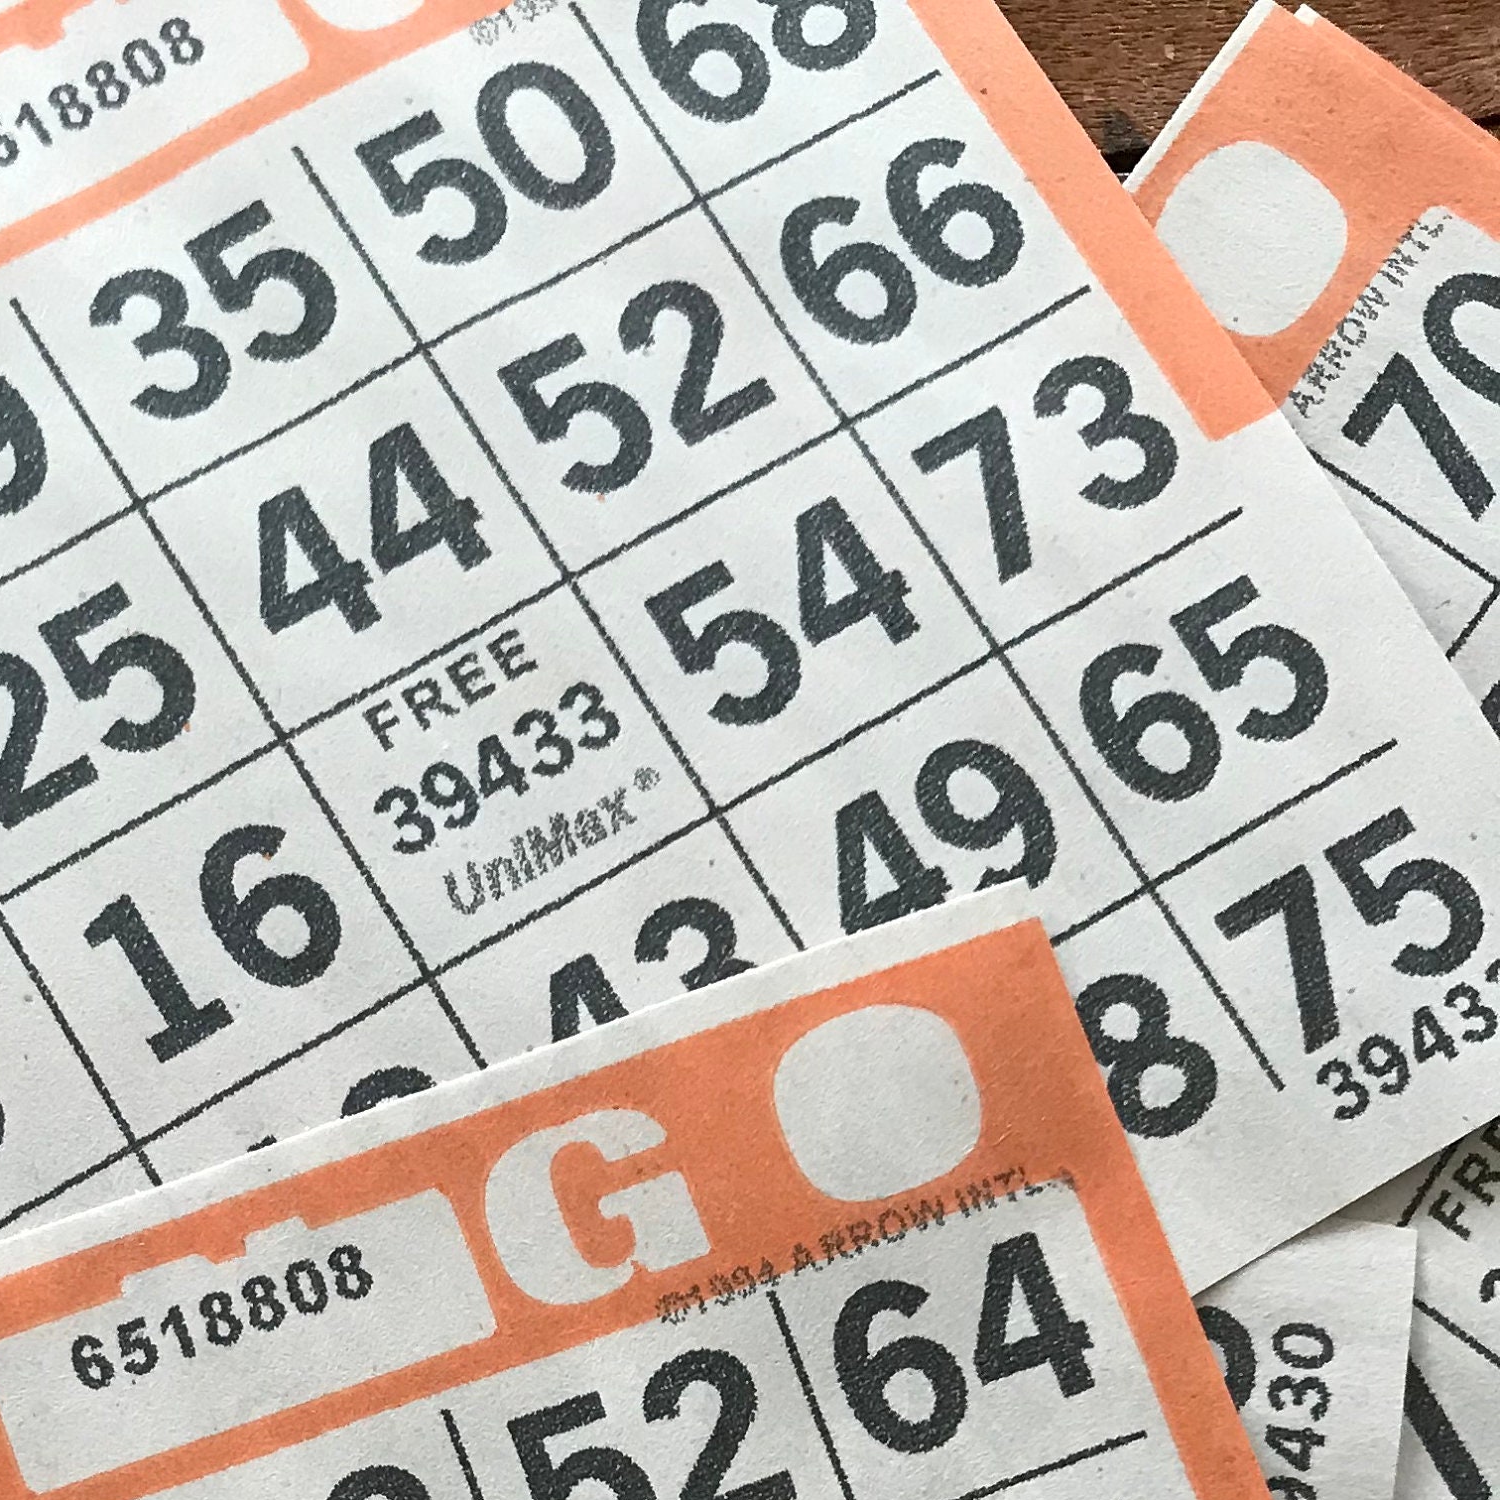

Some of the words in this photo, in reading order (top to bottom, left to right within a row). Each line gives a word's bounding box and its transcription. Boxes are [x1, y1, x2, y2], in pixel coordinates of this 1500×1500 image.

[89, 200, 337, 419] 35
[355, 62, 615, 265] 50
[257, 422, 492, 635] 44
[497, 280, 776, 495] 52
[780, 139, 1024, 344] 66
[1289, 285, 1390, 418] ARROW
[83, 825, 341, 1063] 16
[361, 628, 538, 752] FREE
[644, 496, 921, 726] 54
[911, 356, 1179, 584] 73
[373, 681, 621, 853] 39433
[835, 739, 1058, 935] 49
[1079, 575, 1328, 802] 65
[1214, 806, 1485, 1054] 75
[1316, 958, 1500, 1121] 3943
[485, 1107, 711, 1305] G
[792, 1196, 946, 1275] ARROW
[70, 1245, 374, 1390] 6518808
[833, 1231, 1095, 1455] 64
